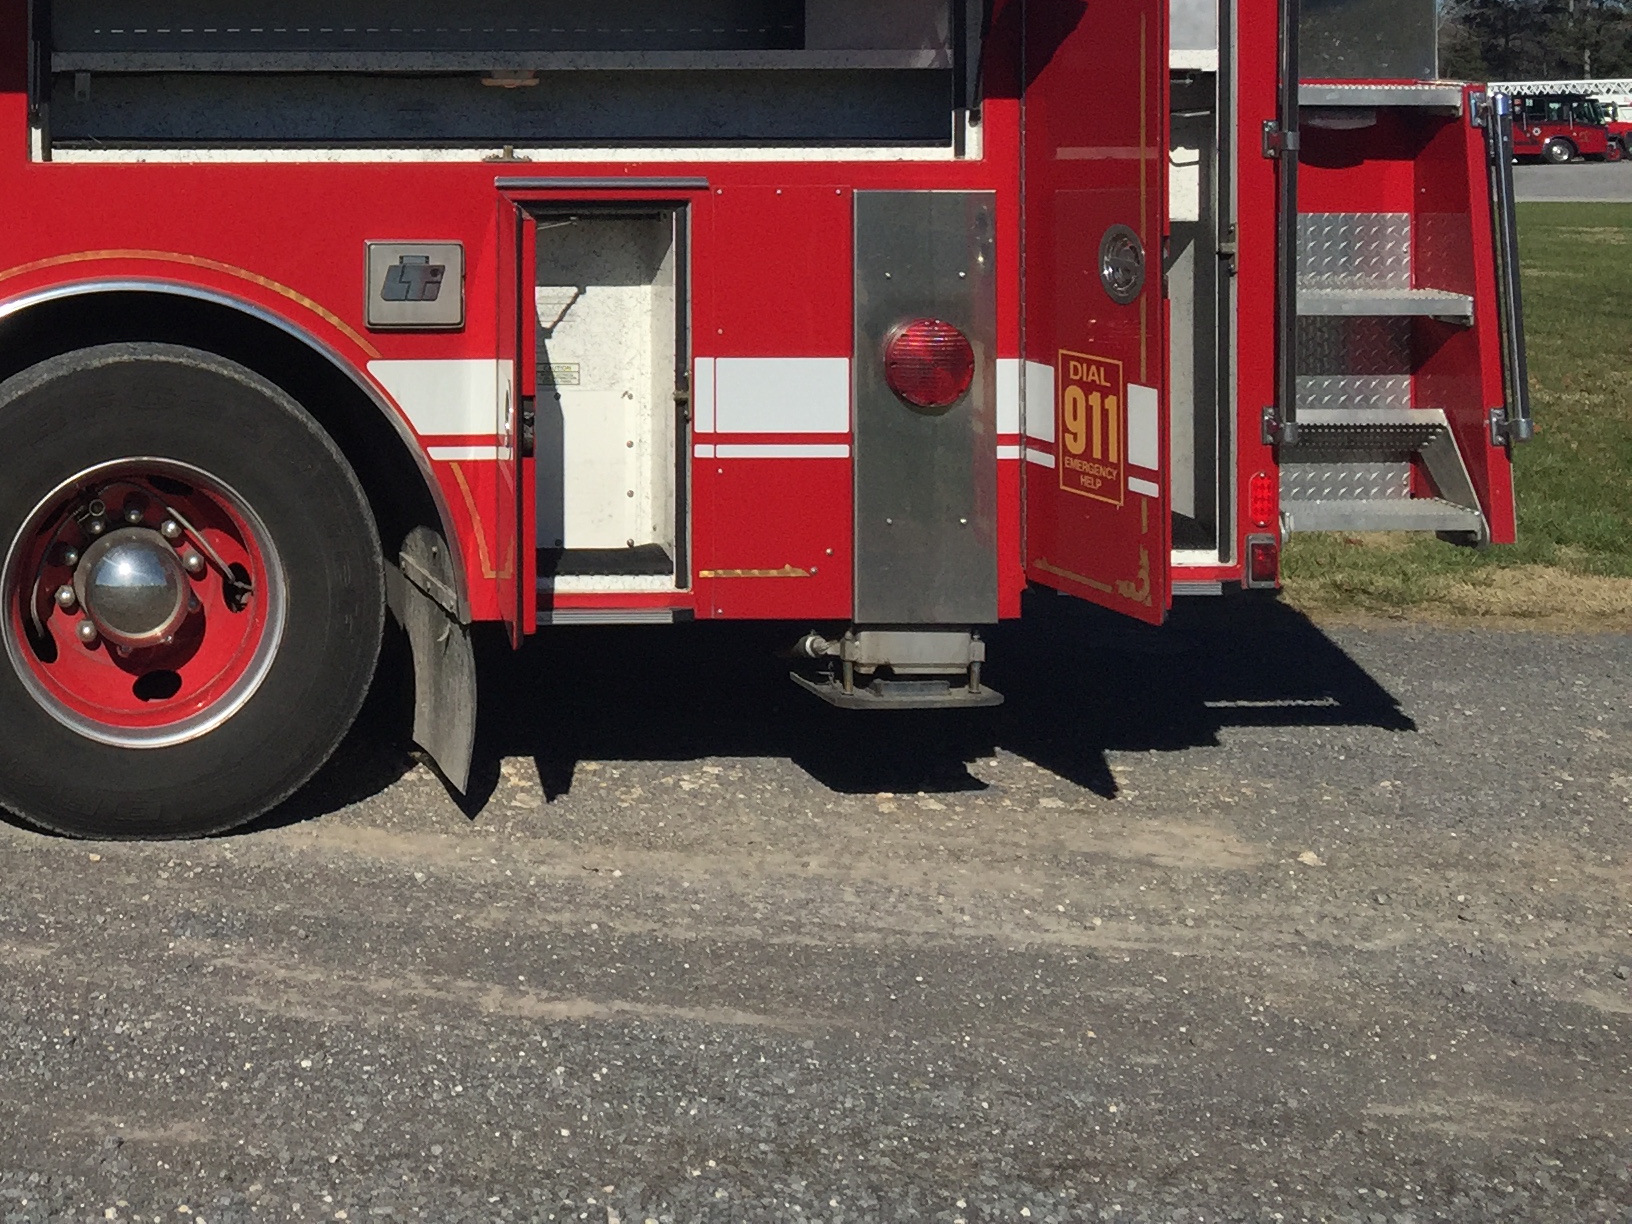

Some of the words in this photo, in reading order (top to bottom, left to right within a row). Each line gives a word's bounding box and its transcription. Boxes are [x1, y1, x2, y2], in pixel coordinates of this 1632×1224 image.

[1069, 360, 1111, 387] DIAL
[1064, 384, 1118, 464] 911
[1064, 456, 1118, 480] EMERGENCY
[1080, 474, 1102, 490] HELP
